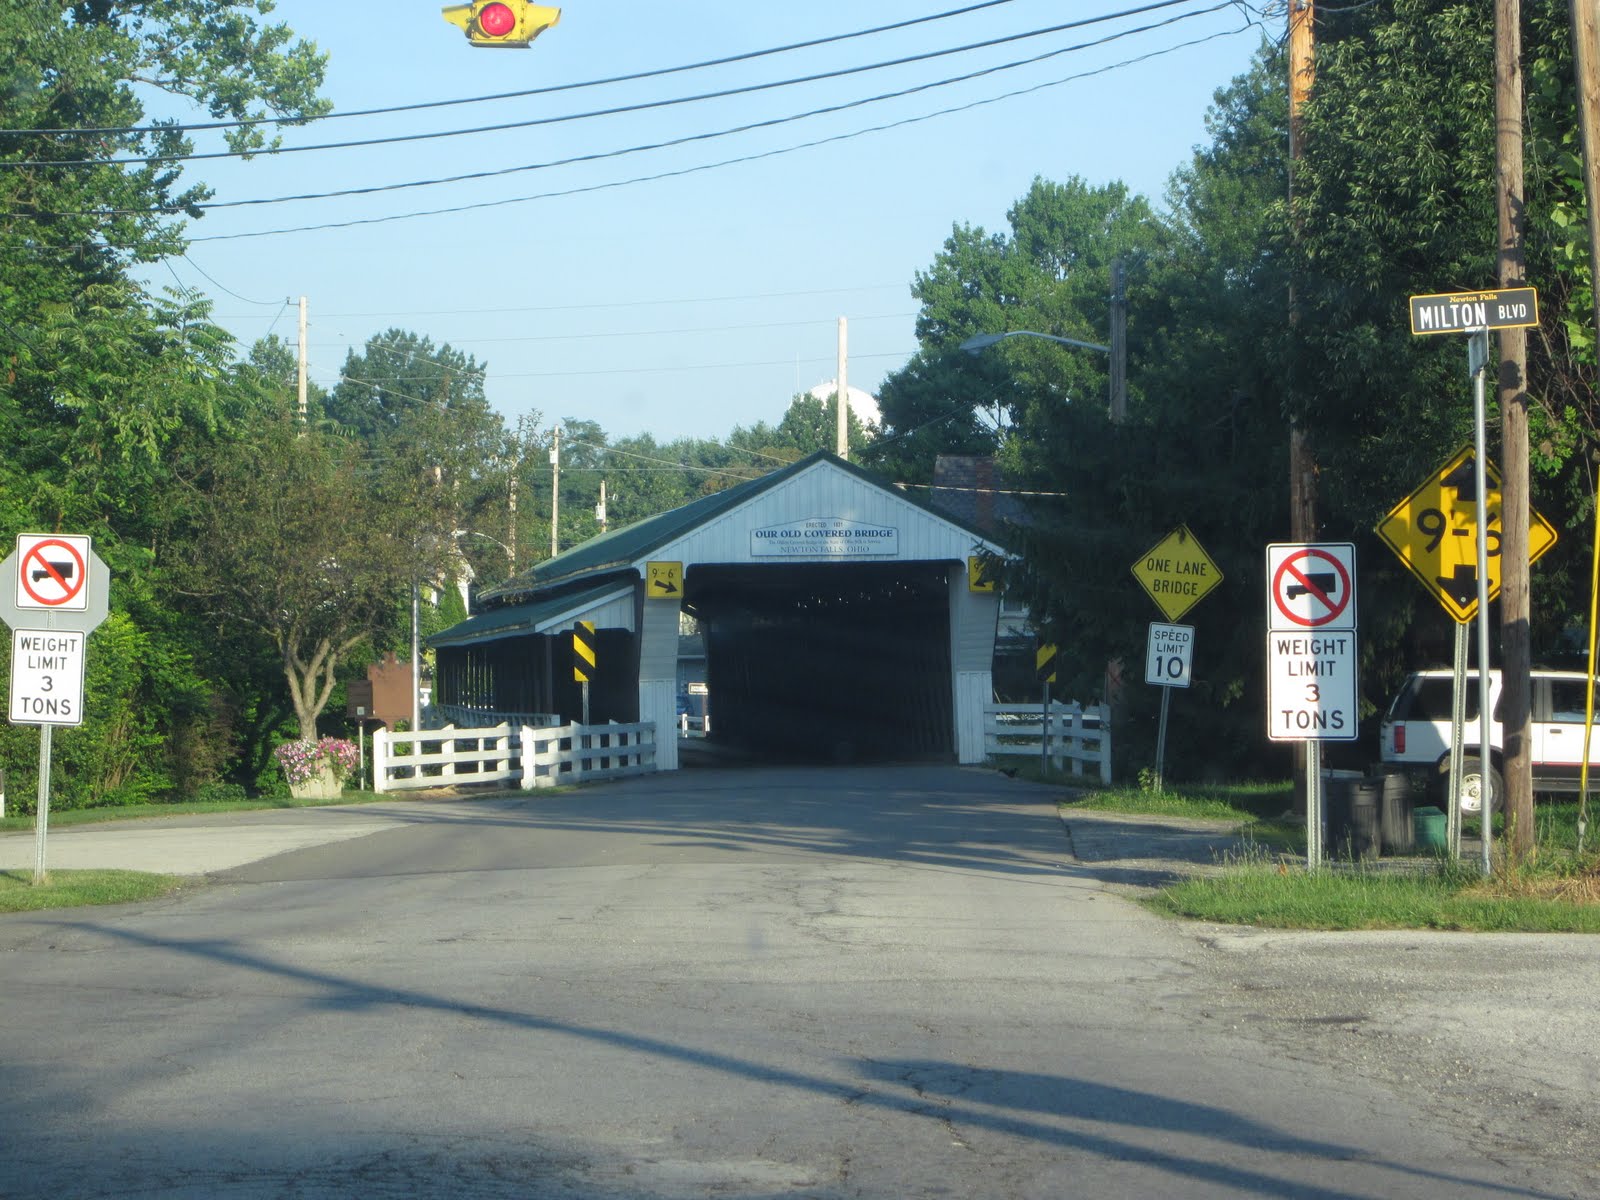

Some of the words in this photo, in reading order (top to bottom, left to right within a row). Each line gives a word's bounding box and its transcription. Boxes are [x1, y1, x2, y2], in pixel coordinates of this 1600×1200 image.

[1449, 295, 1477, 303] Newton
[1479, 293, 1498, 301] Falls
[1419, 302, 1487, 329] MILTON
[1498, 303, 1527, 320] BLVD
[755, 530, 778, 538] OUR
[780, 530, 801, 538] OLD
[804, 530, 852, 538] COVERED
[854, 529, 893, 538] BRIDGE
[1146, 557, 1171, 573] ONE
[1176, 561, 1207, 577] LANE
[1153, 579, 1198, 596] BRIDGE
[20, 636, 78, 653] WEIGHT
[1154, 630, 1190, 642] SPEED
[1156, 643, 1185, 654] LIMIT
[1277, 639, 1347, 655] WEIGHT
[28, 656, 68, 670] LIMIT
[1155, 655, 1184, 679] 10
[1288, 661, 1336, 676] LIMIT
[41, 675, 53, 692] 3
[1305, 683, 1320, 702] 3
[21, 697, 71, 715] TONS
[1281, 710, 1344, 730] TONS
